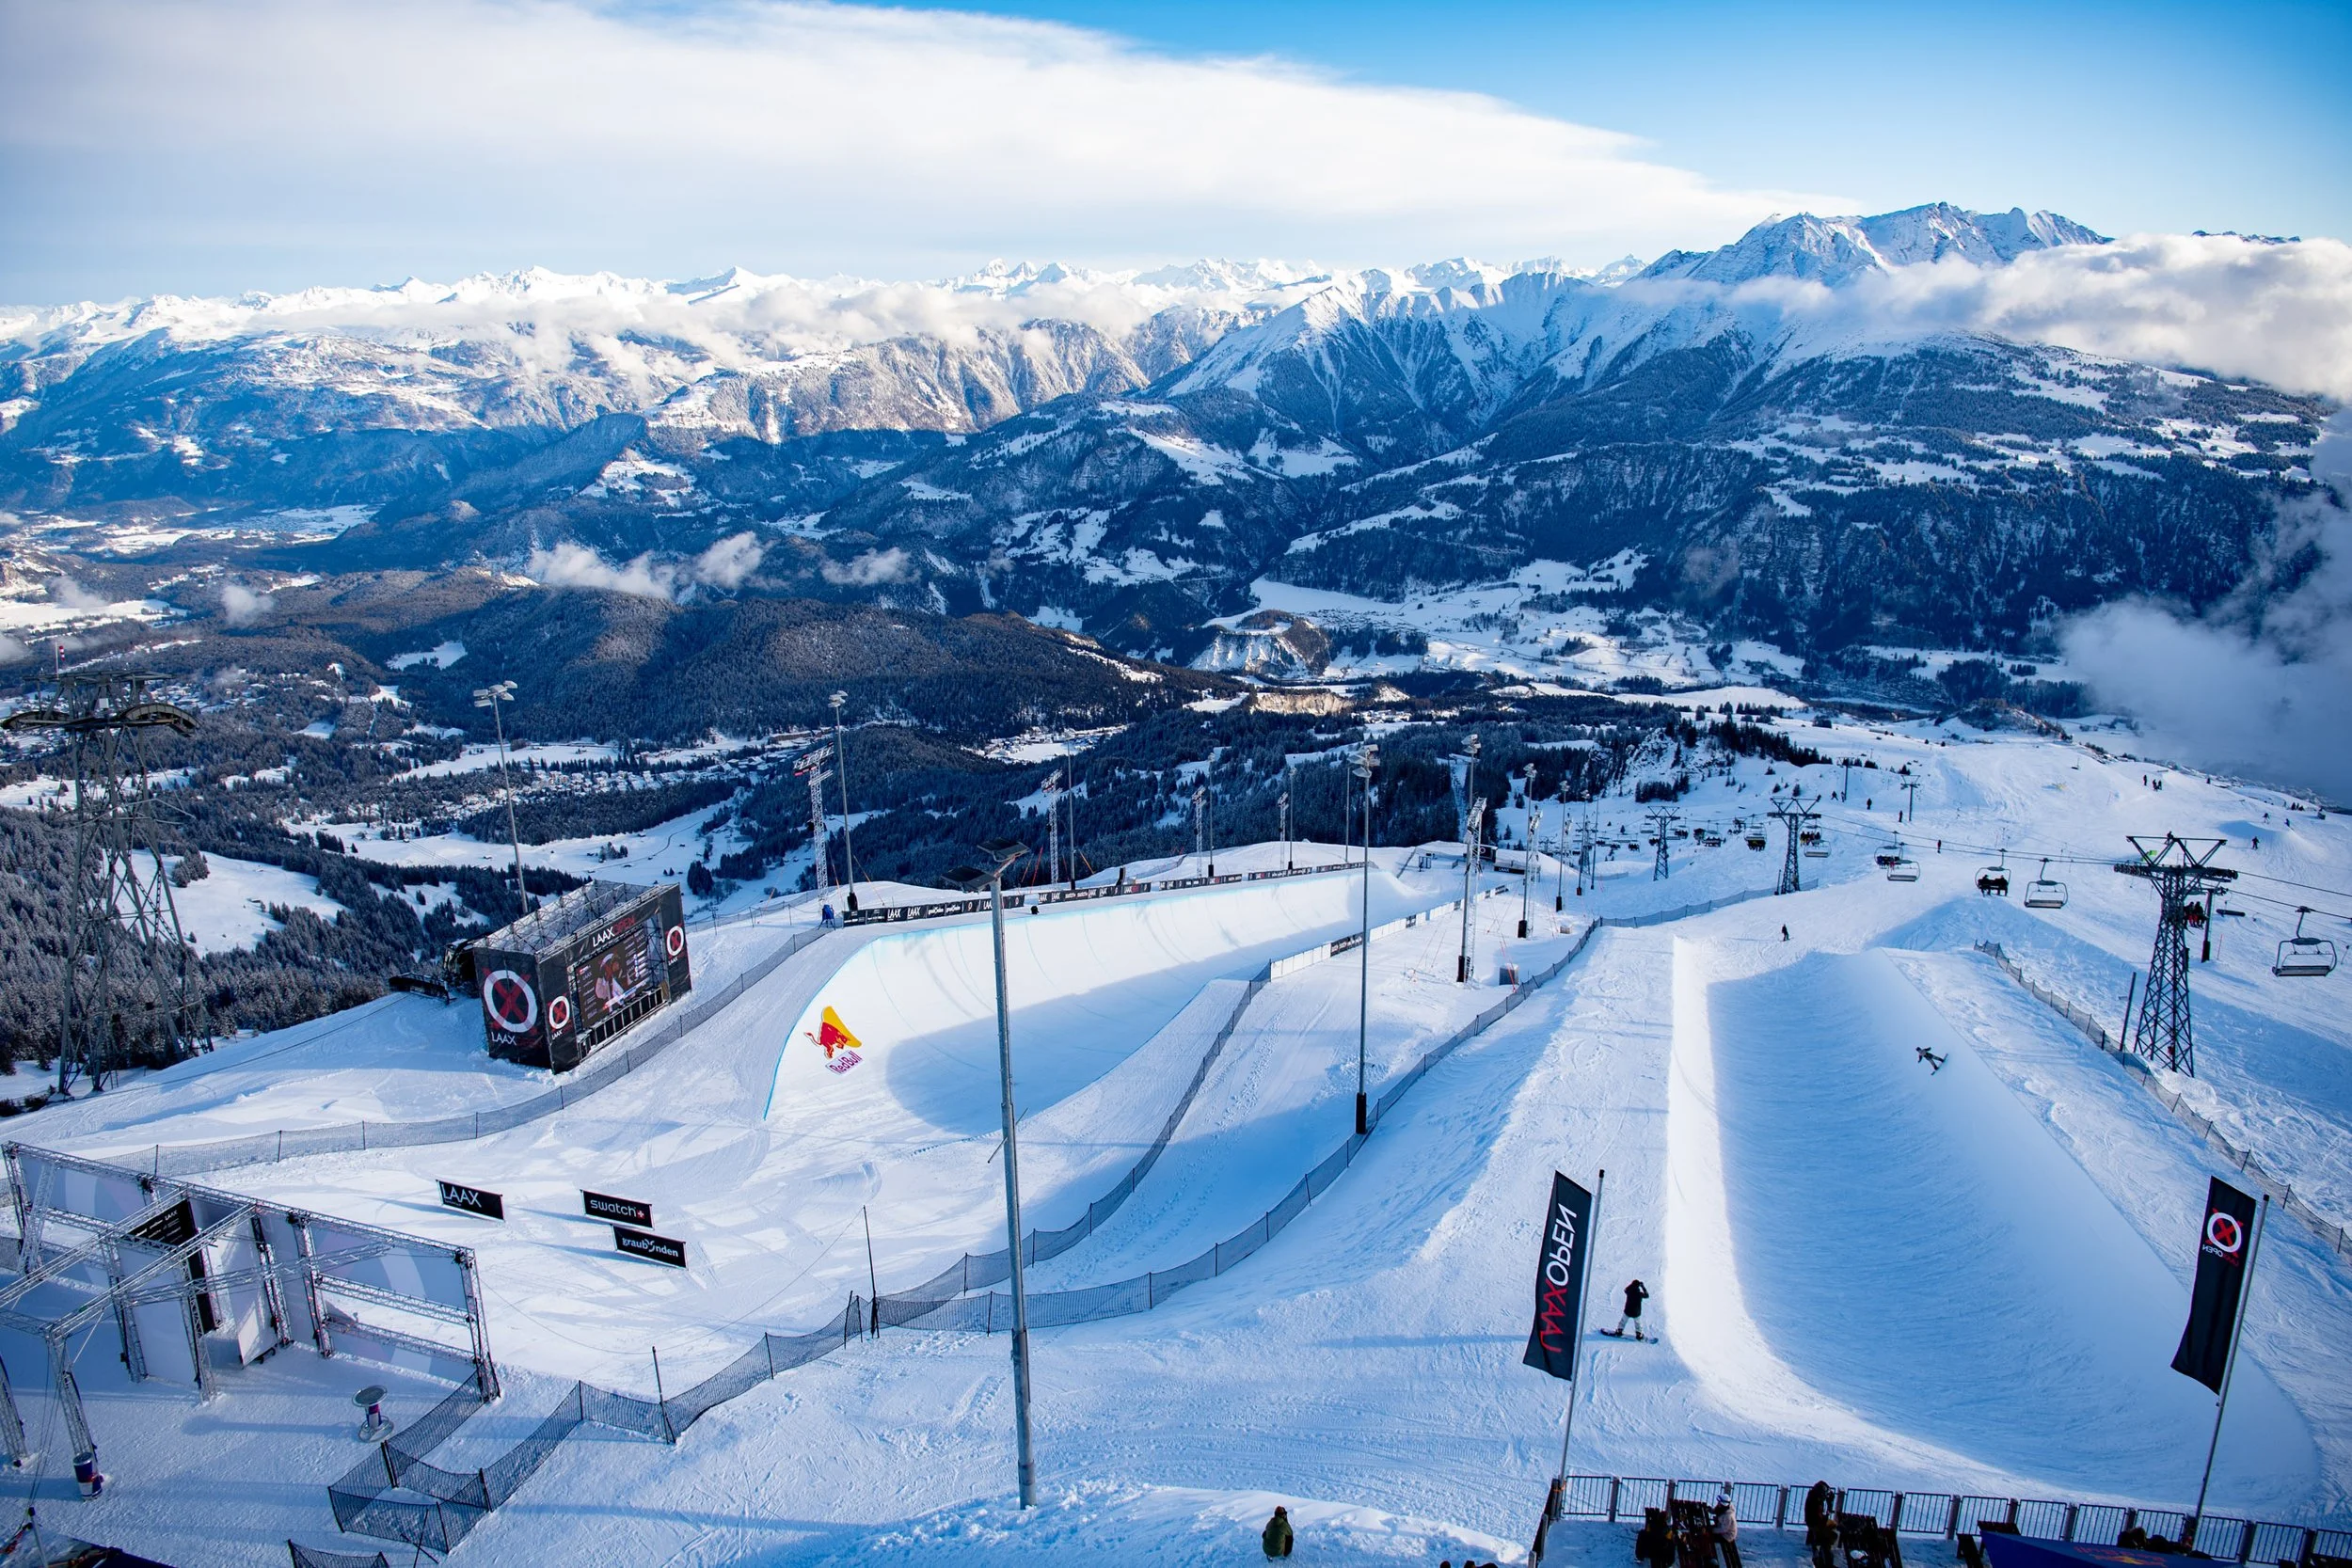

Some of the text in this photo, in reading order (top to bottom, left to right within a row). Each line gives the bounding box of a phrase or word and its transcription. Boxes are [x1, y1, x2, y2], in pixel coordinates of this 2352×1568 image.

[887, 909, 901, 919] LAAX
[907, 907, 921, 917] LAAX
[593, 926, 614, 947] LAAX
[491, 1031, 516, 1045] LAAX
[441, 1183, 483, 1208] LAAX
[165, 1210, 178, 1221] LAAX
[590, 1199, 637, 1218] swatch
